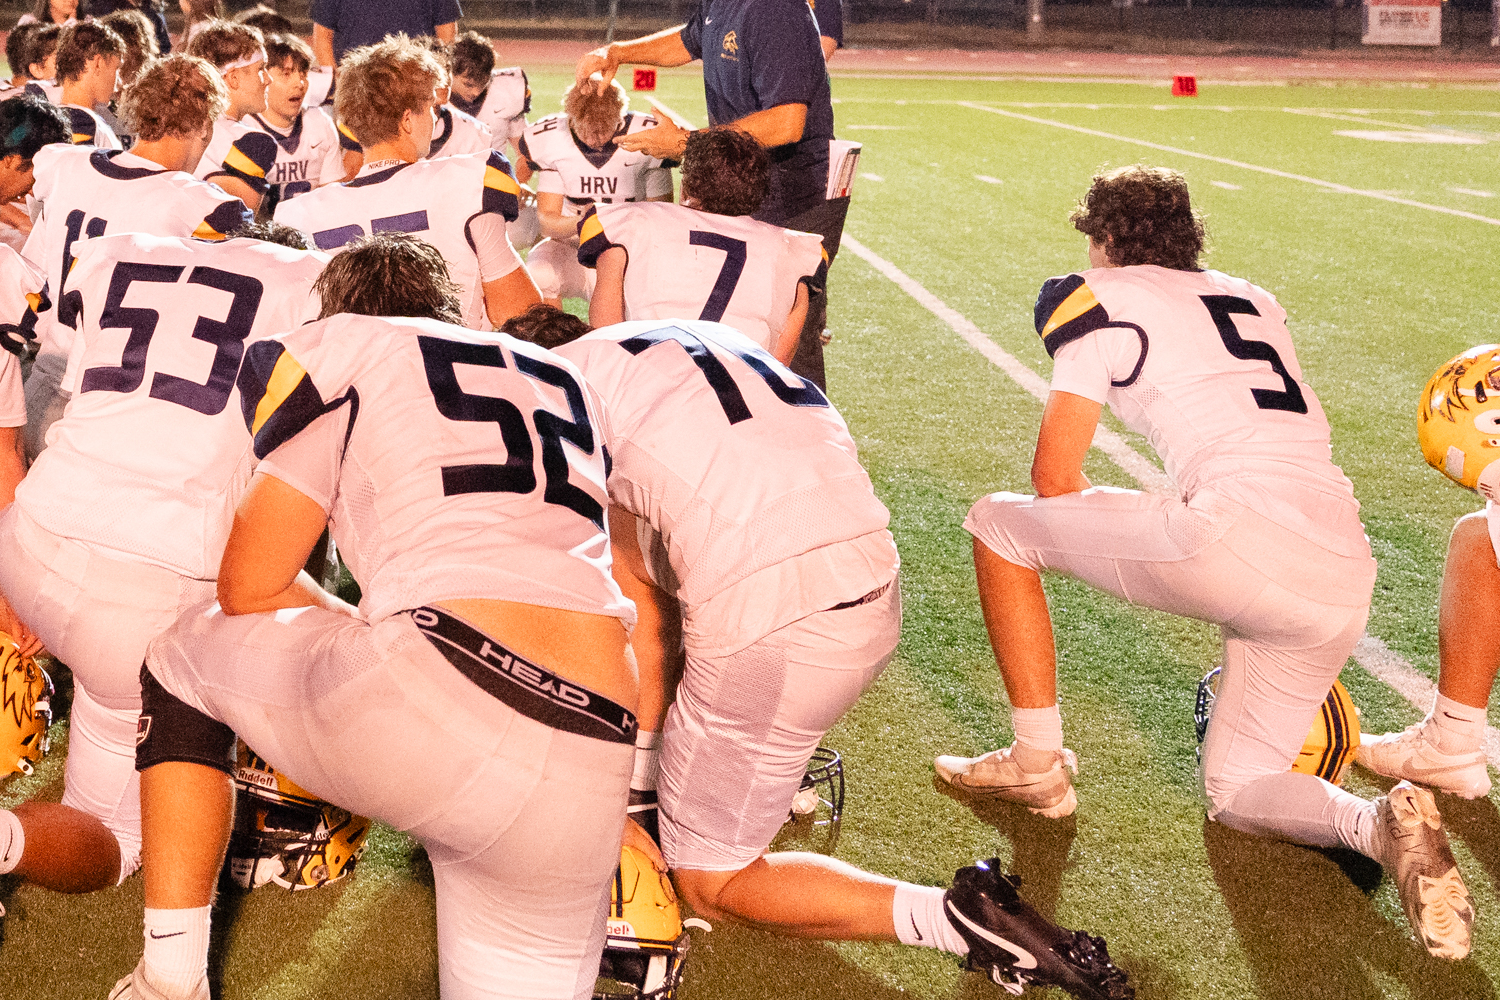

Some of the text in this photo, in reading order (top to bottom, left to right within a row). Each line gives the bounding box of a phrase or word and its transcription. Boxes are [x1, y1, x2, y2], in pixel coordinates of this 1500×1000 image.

[635, 69, 656, 90] 20
[275, 160, 309, 182] HRV
[368, 159, 401, 170] NIKE PRO
[580, 176, 618, 195] HRV
[57, 209, 108, 331] 1
[689, 230, 747, 323] 7
[81, 261, 264, 416] 53
[1197, 294, 1309, 414] 5
[417, 335, 607, 533] 52
[480, 641, 591, 707] HEAD
